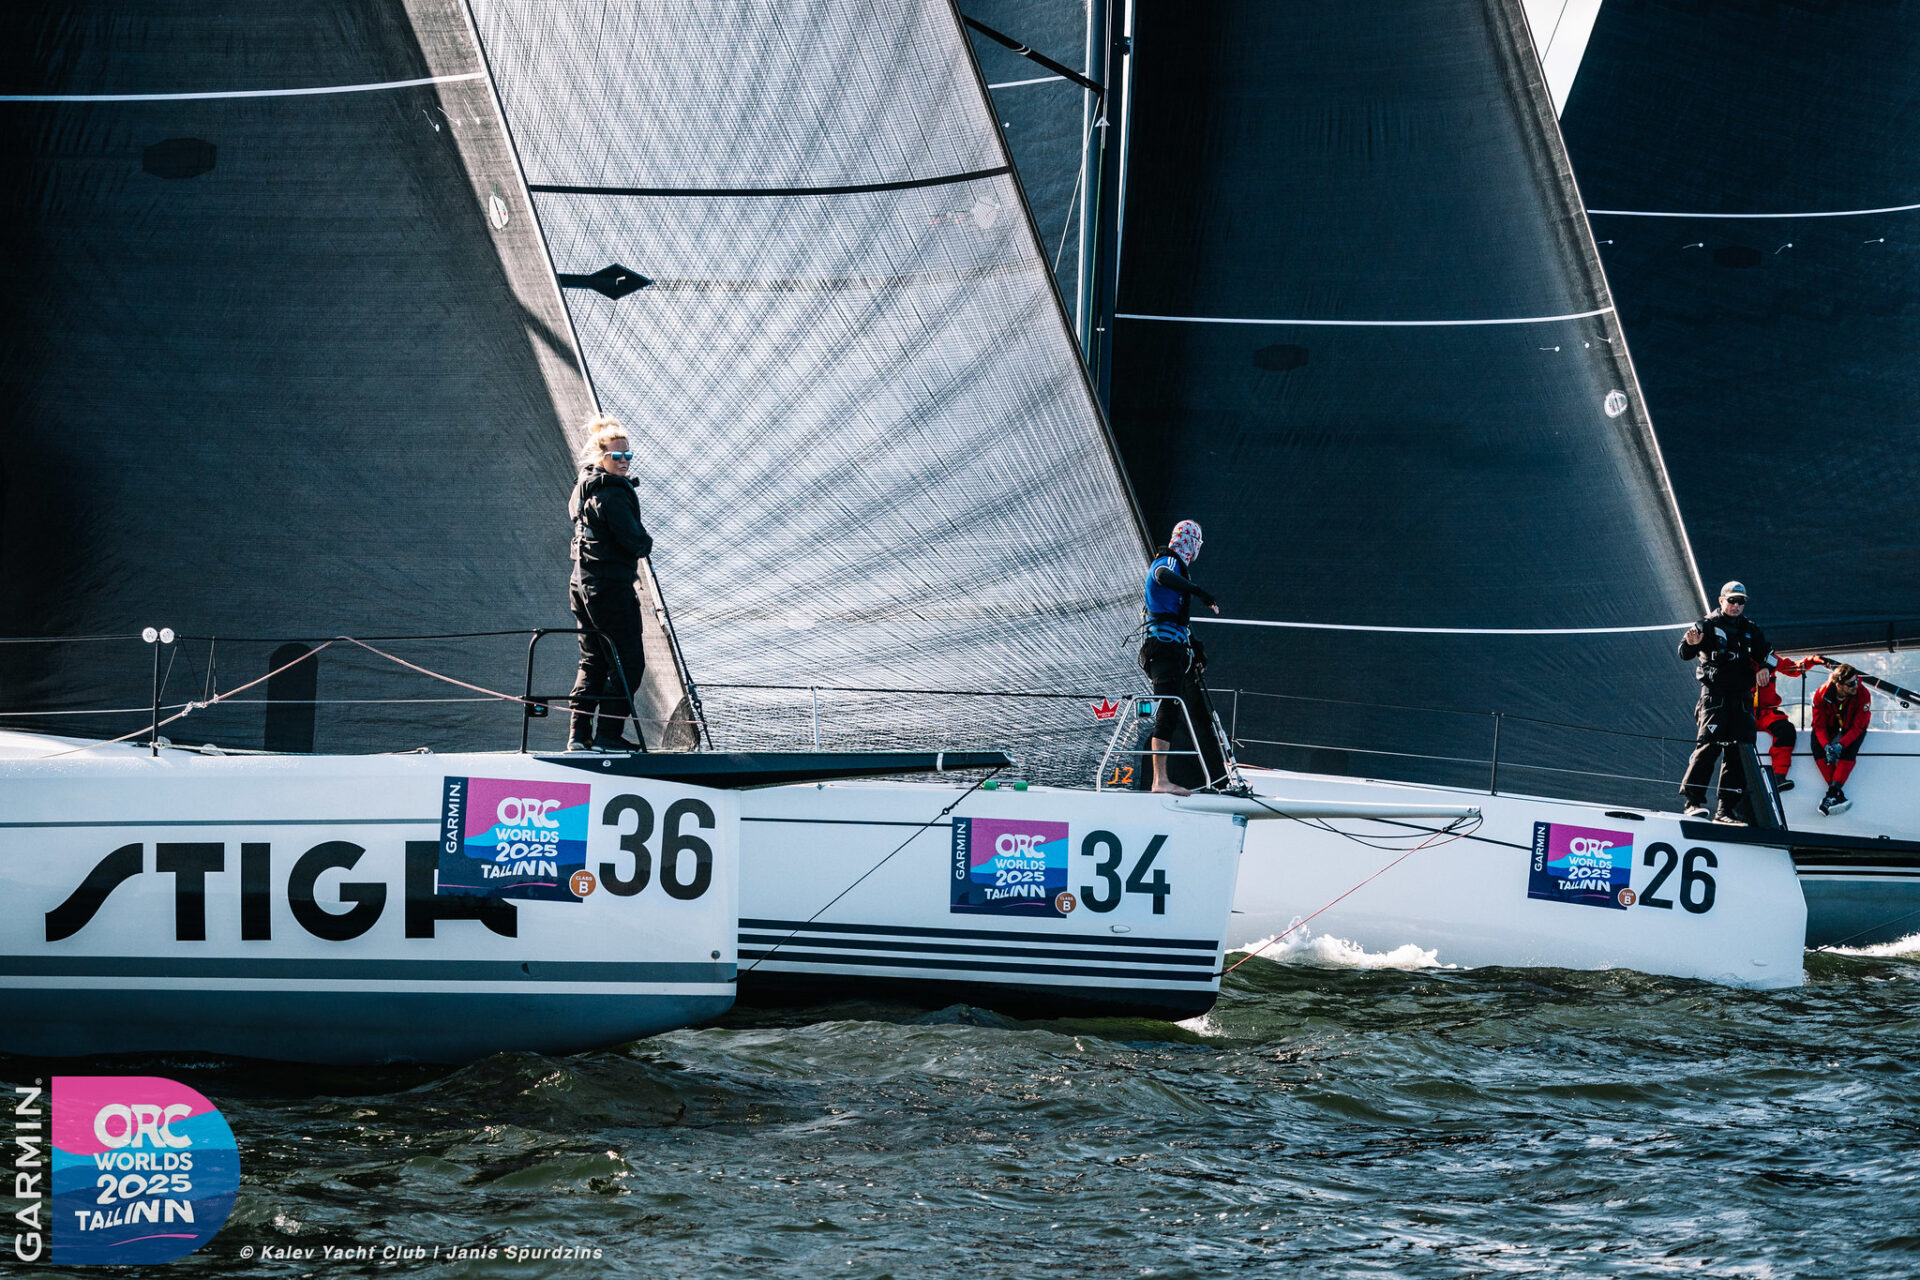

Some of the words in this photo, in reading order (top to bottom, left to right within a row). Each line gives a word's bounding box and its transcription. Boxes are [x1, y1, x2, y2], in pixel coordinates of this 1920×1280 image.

[497, 797, 561, 828] ORC
[495, 828, 560, 844] WORLDS
[496, 842, 558, 862] 2025
[599, 793, 716, 900] 36
[995, 833, 1046, 859] ORC
[1569, 837, 1614, 860] ORC
[481, 860, 558, 878] TALLINN
[995, 858, 1046, 871] WORLDS
[1569, 856, 1613, 869] WORLDS
[995, 870, 1045, 886] 2025
[1080, 830, 1171, 915] 34
[1568, 866, 1611, 880] 2025
[1639, 841, 1718, 914] 26
[579, 881, 588, 893] B
[984, 884, 1046, 900] TALLINN
[1558, 879, 1611, 892] TALLINN
[1063, 900, 1071, 911] B
